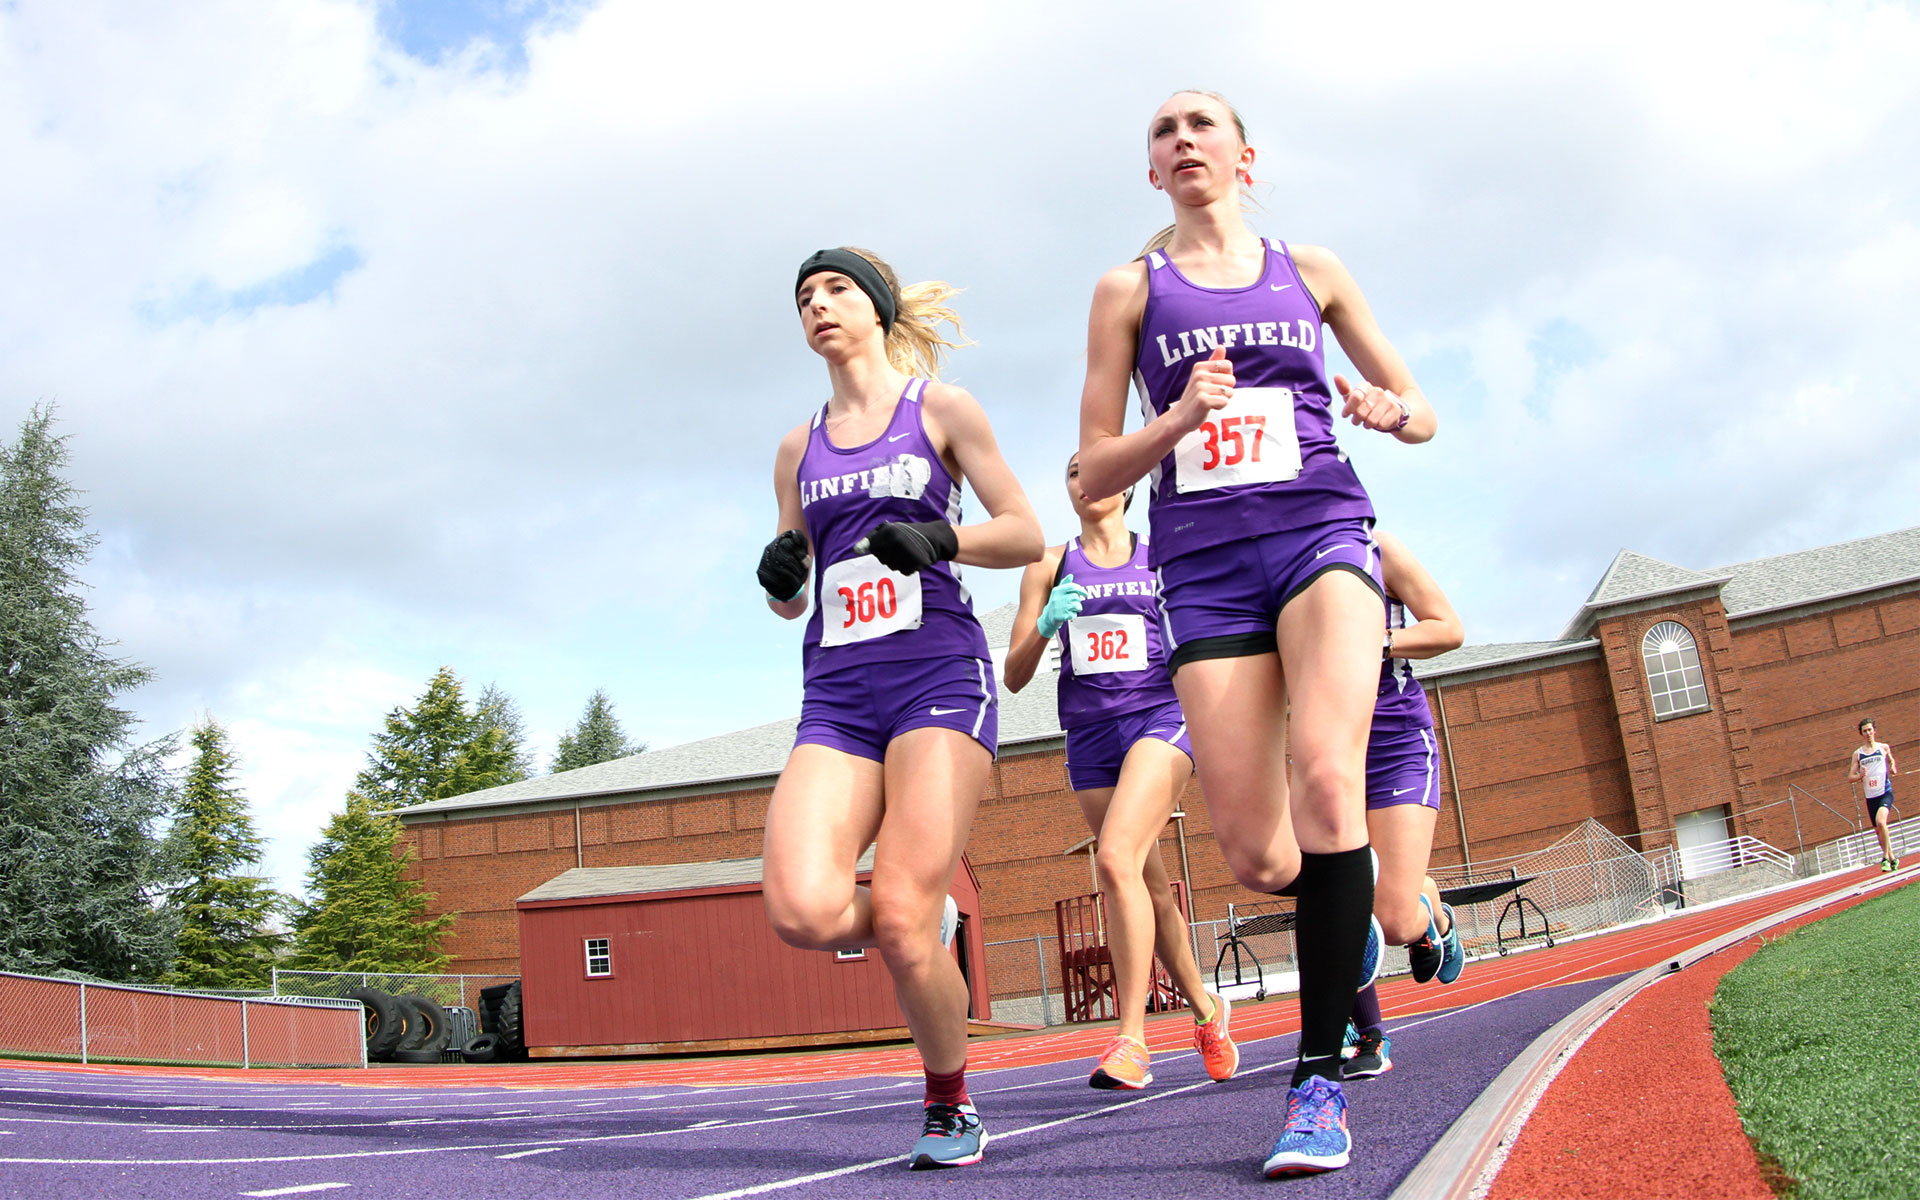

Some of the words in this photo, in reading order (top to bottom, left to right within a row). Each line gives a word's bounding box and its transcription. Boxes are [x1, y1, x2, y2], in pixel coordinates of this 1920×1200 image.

[1156, 319, 1316, 368] LINFIELD
[1199, 415, 1266, 471] 357
[837, 577, 897, 629] 360
[1087, 629, 1130, 662] 362
